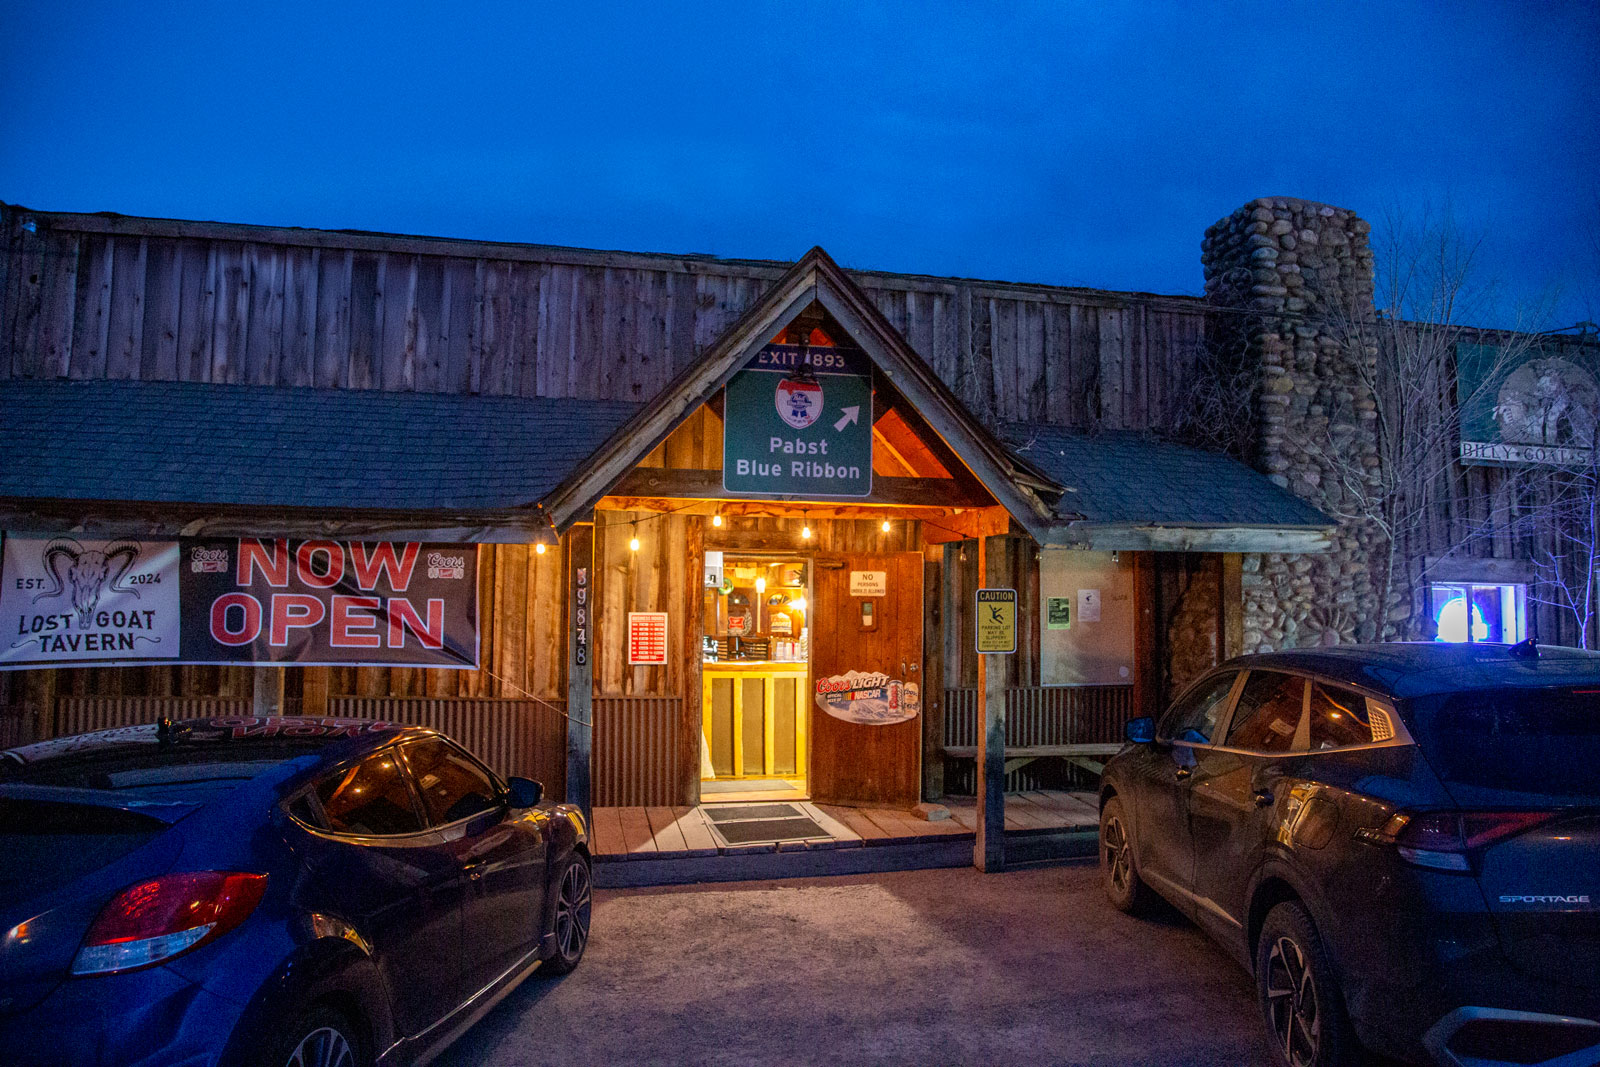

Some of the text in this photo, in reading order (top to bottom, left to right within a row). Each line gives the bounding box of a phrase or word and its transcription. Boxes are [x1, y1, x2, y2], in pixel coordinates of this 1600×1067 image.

[758, 351, 845, 368] EXIT 893
[770, 437, 828, 455] Pabst
[1463, 443, 1512, 459] BILLY
[736, 459, 860, 479] Blue Ribbon
[191, 545, 229, 561] Coors
[428, 552, 465, 568] Coors
[236, 537, 422, 592] NOW
[16, 573, 161, 590] EST. 2024
[862, 573, 874, 581] NO
[980, 591, 1013, 601] CAUTION
[18, 609, 156, 635] LOST GOAT
[210, 592, 444, 649] OPEN
[38, 632, 135, 653] TAVERN
[816, 675, 890, 693] Coors LIGHT
[854, 688, 881, 700] NASCAR
[1498, 895, 1590, 903] SPORTAGE
